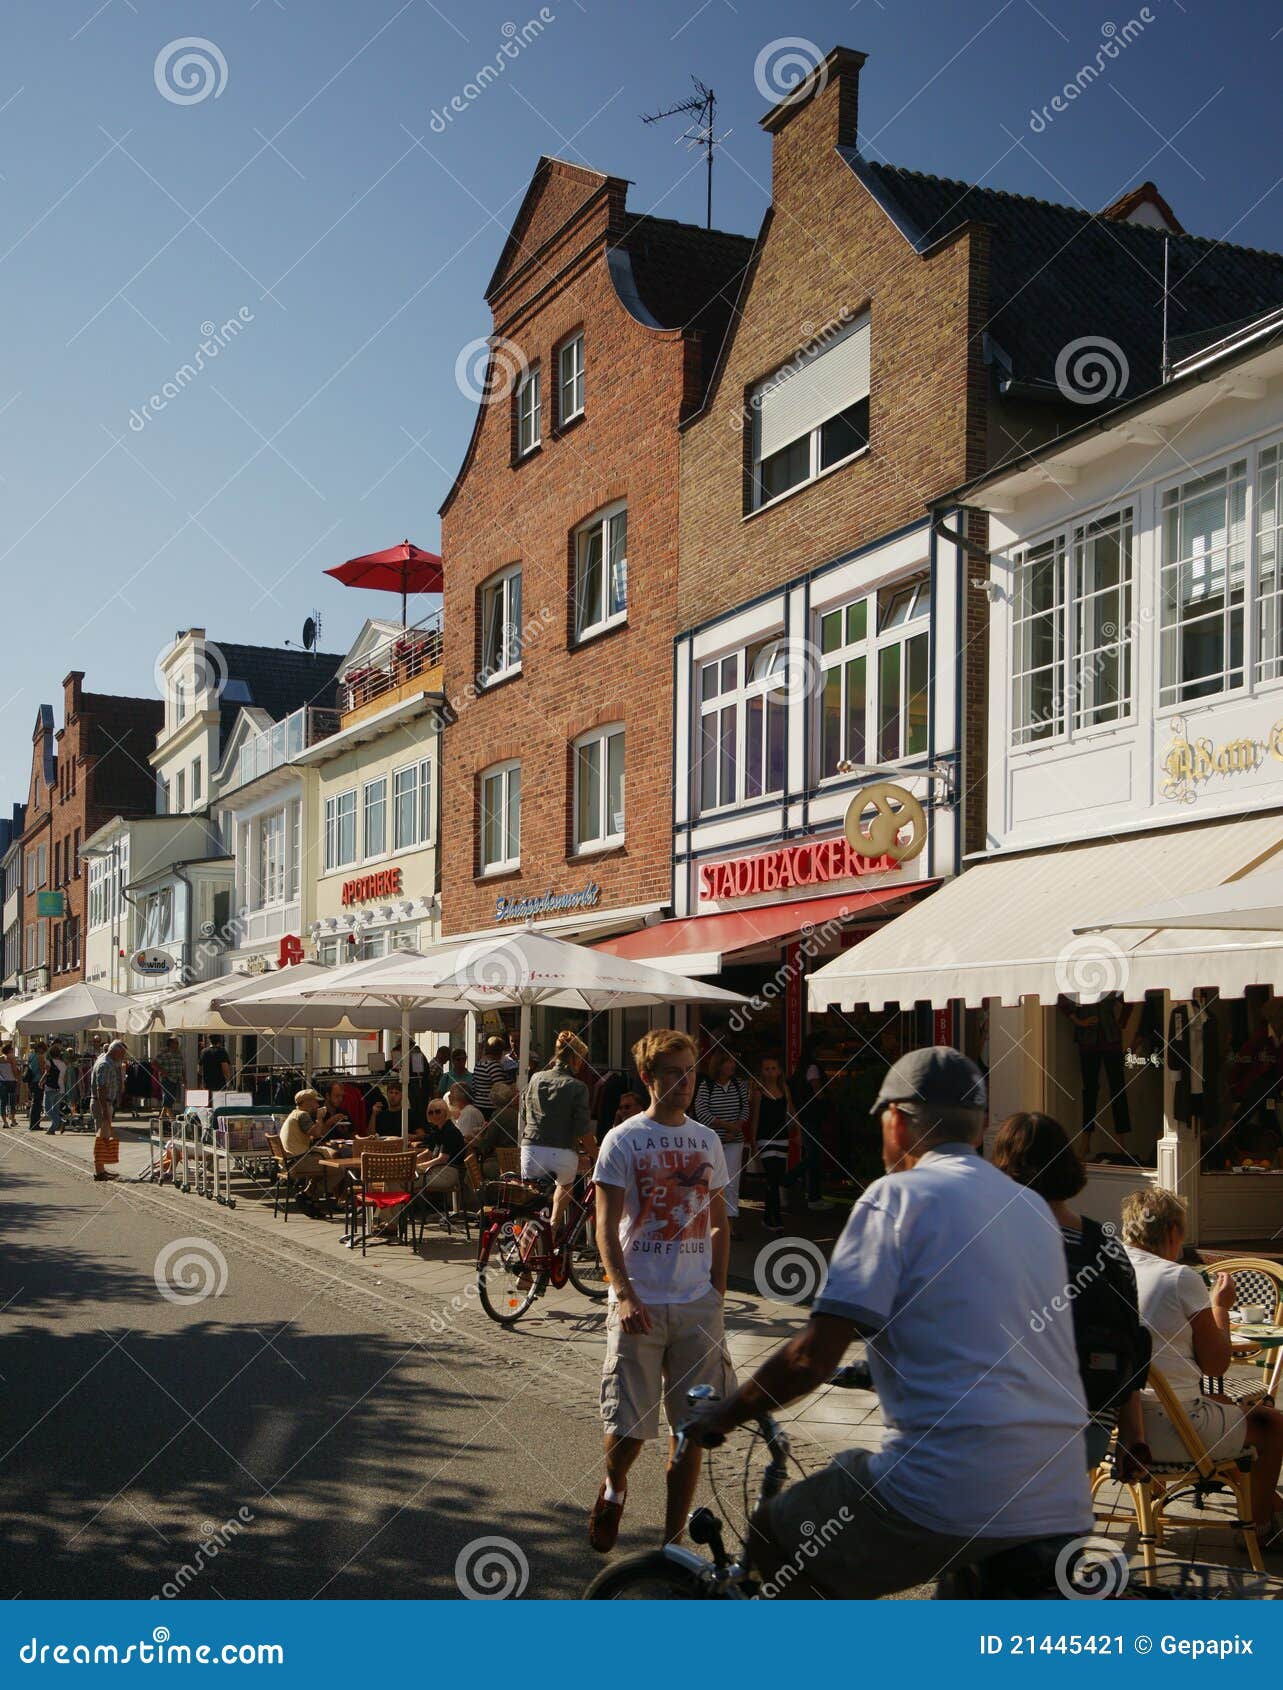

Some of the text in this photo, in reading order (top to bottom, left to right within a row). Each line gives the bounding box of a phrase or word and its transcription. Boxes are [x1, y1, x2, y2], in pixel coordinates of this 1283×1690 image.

[341, 867, 401, 906] APOTHEKE
[632, 1136, 709, 1151] LAGUNA
[636, 1154, 691, 1170] CALIF
[632, 1240, 705, 1254] SURF CLUB
